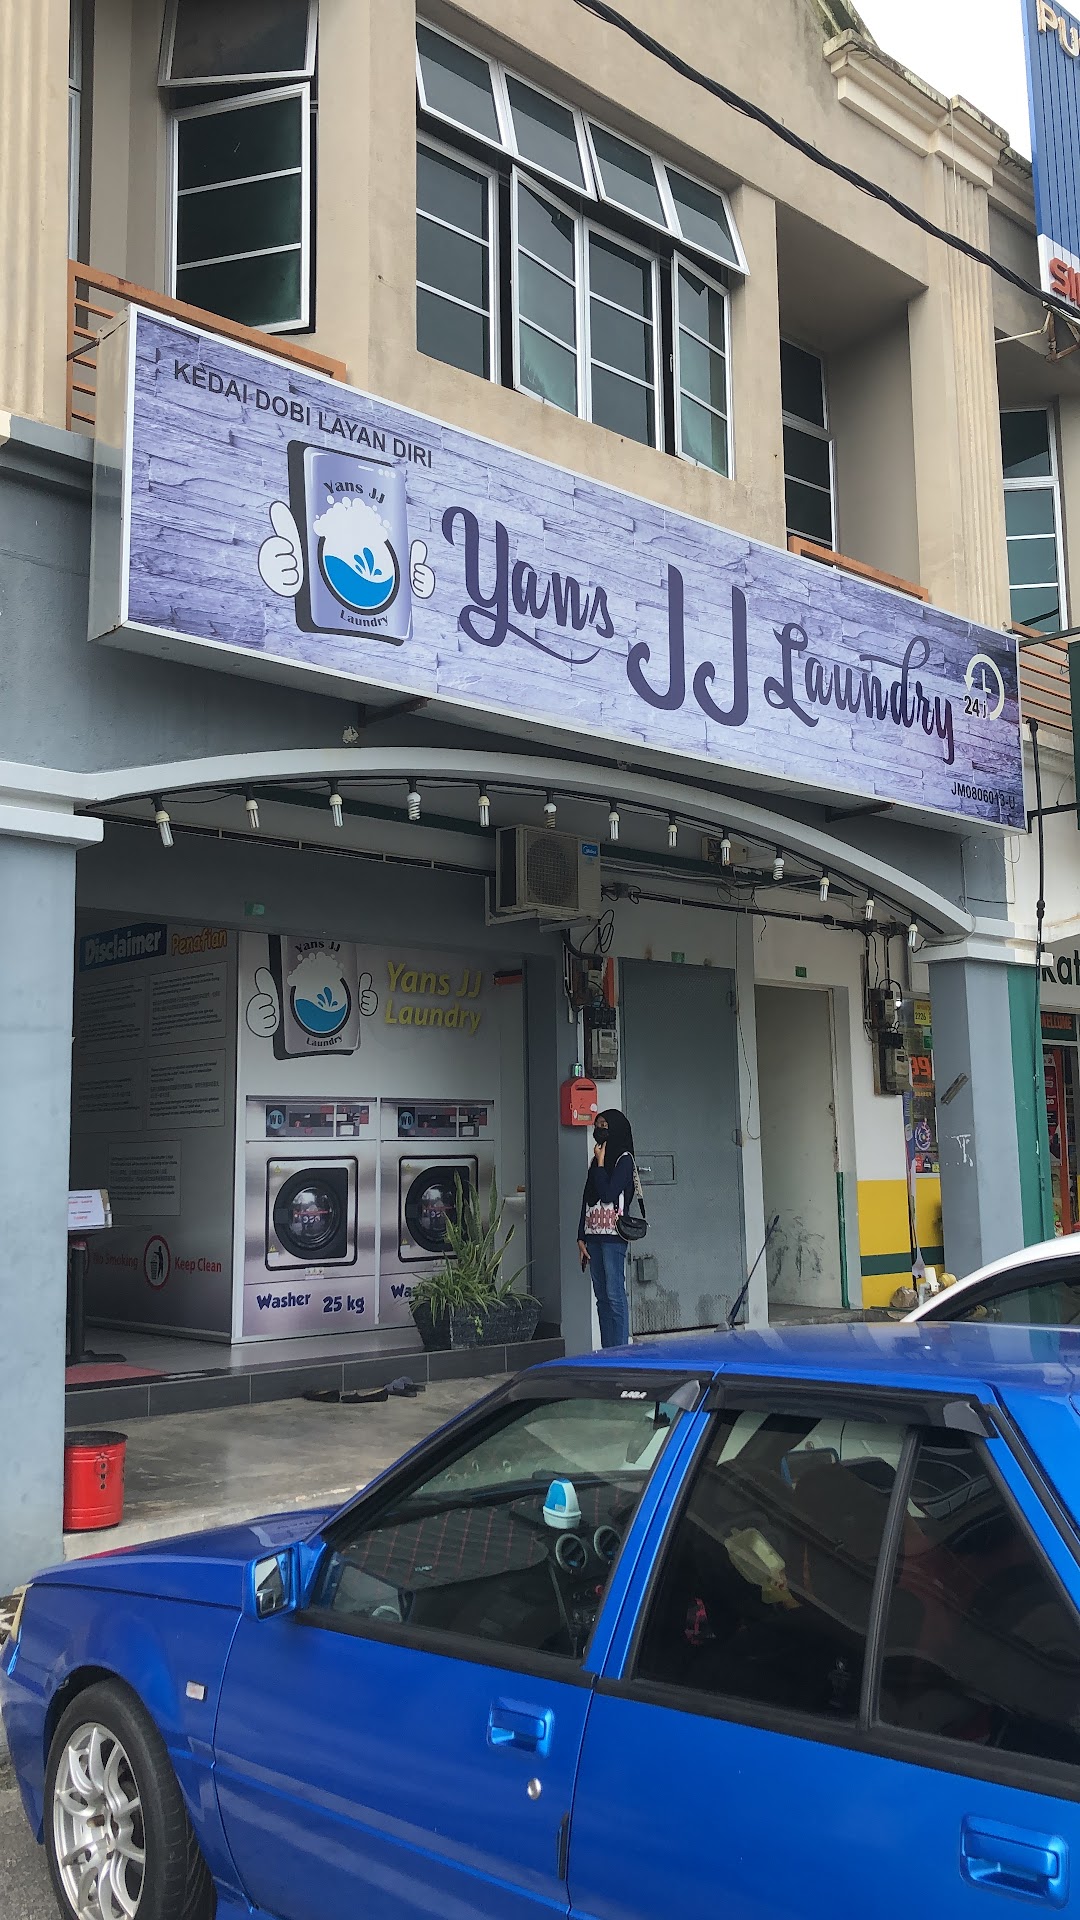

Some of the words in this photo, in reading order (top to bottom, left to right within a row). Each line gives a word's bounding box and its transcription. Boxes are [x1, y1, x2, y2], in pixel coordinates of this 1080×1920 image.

[1036, 0, 1080, 59] PU
[173, 359, 248, 403] KEDAI
[255, 389, 311, 426] DOBI
[318, 410, 386, 453] LAYAN
[392, 438, 433, 469] DIRI
[323, 478, 364, 495] Yans
[368, 487, 386, 504] JJ
[339, 608, 389, 628] Laundry
[441, 506, 615, 664] Yans
[626, 563, 749, 727] JJ
[763, 622, 954, 765] Laundry
[964, 695, 981, 718] 24
[84, 930, 163, 966] Disclaimer
[171, 928, 228, 957] Penafian
[295, 940, 325, 953] Yans
[327, 941, 341, 953] JJ
[386, 960, 451, 996] Yans
[456, 968, 483, 998] JJ
[384, 999, 482, 1036] Laundry
[306, 1034, 344, 1047] Laundry
[105, 1252, 139, 1270] Smoking
[174, 1257, 196, 1274] Keep
[197, 1257, 222, 1273] Clean
[256, 1291, 311, 1311] Washer
[322, 1295, 343, 1313] 25
[347, 1294, 365, 1314] kg
